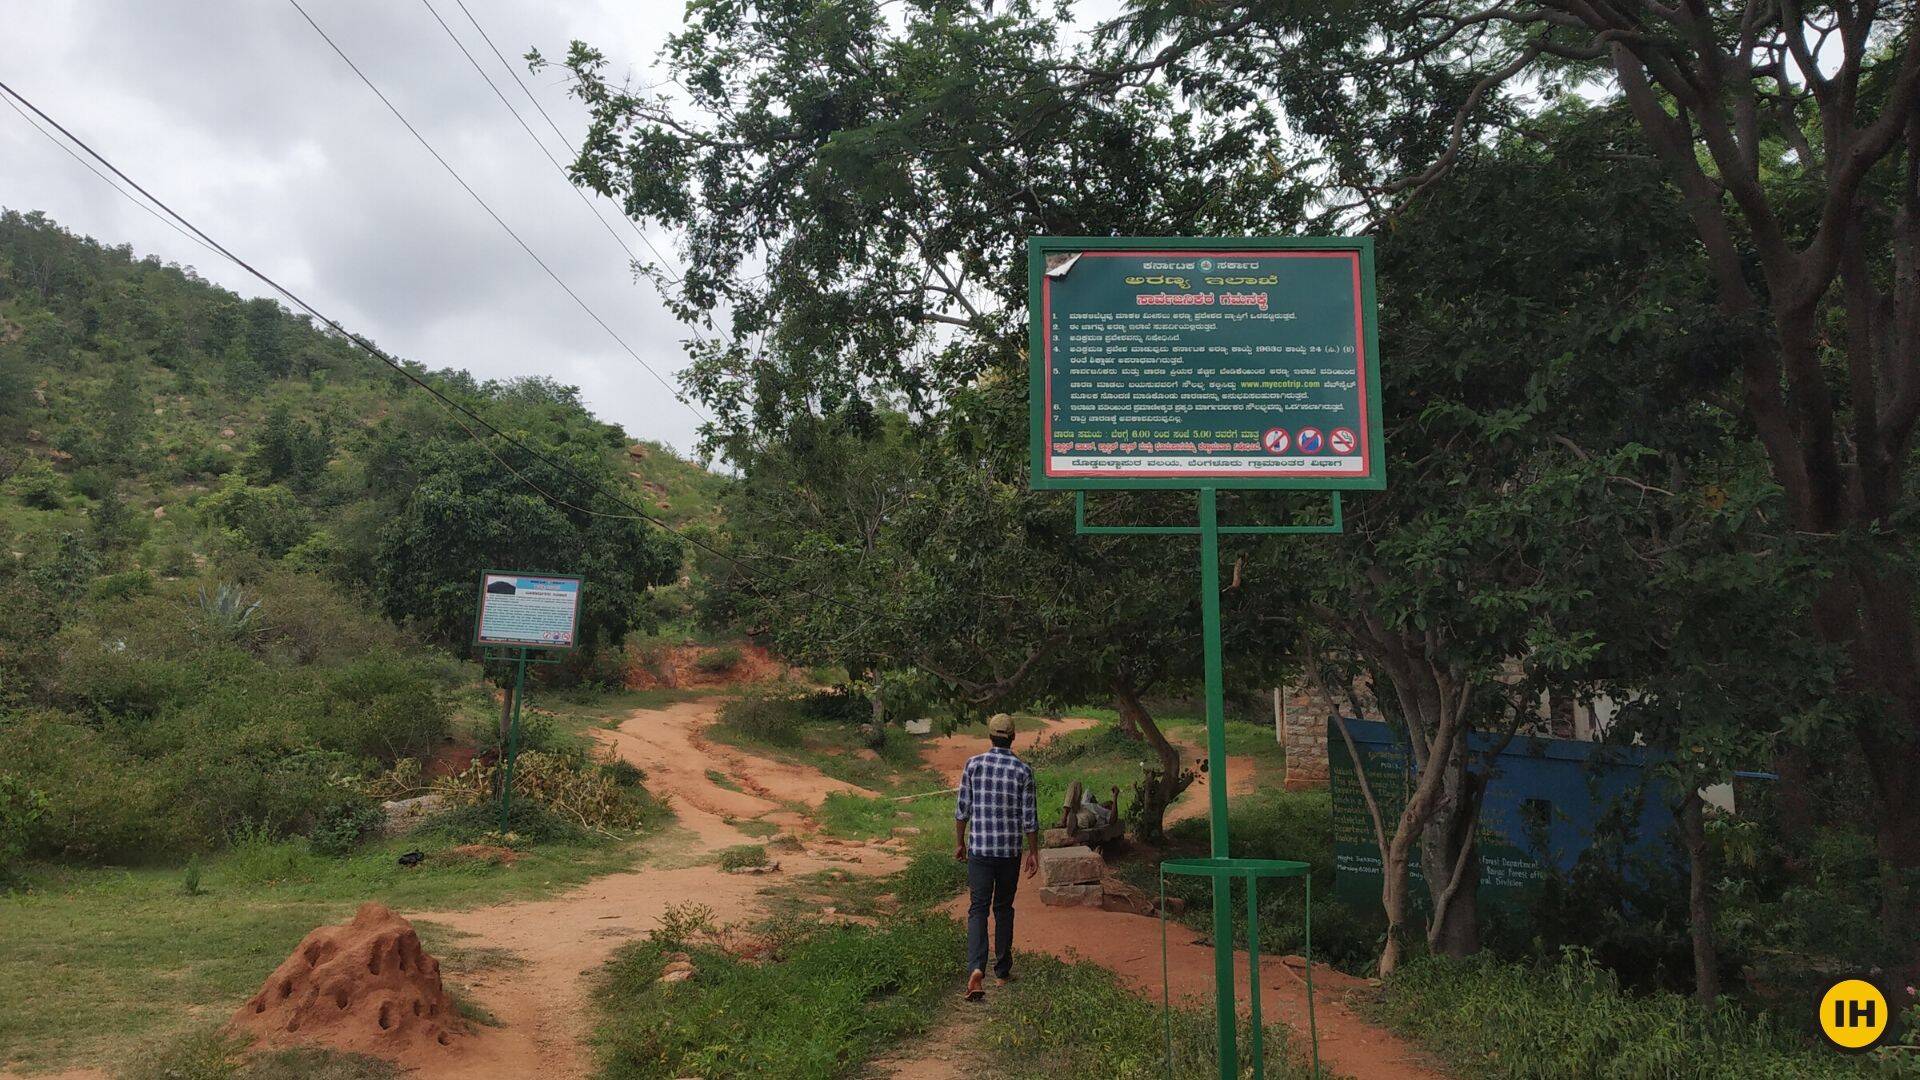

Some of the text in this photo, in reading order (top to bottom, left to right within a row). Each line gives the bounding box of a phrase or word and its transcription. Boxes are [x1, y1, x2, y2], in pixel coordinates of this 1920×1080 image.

[1125, 274, 1278, 289] ಅರಣ್ಯ ಇಲಾಖೆ
[1136, 292, 1268, 311] ಸಾರ್ವಜನಿಕರ ಗಮನಕ್ಕೆ
[1240, 380, 1320, 390] www.myecotrip.com
